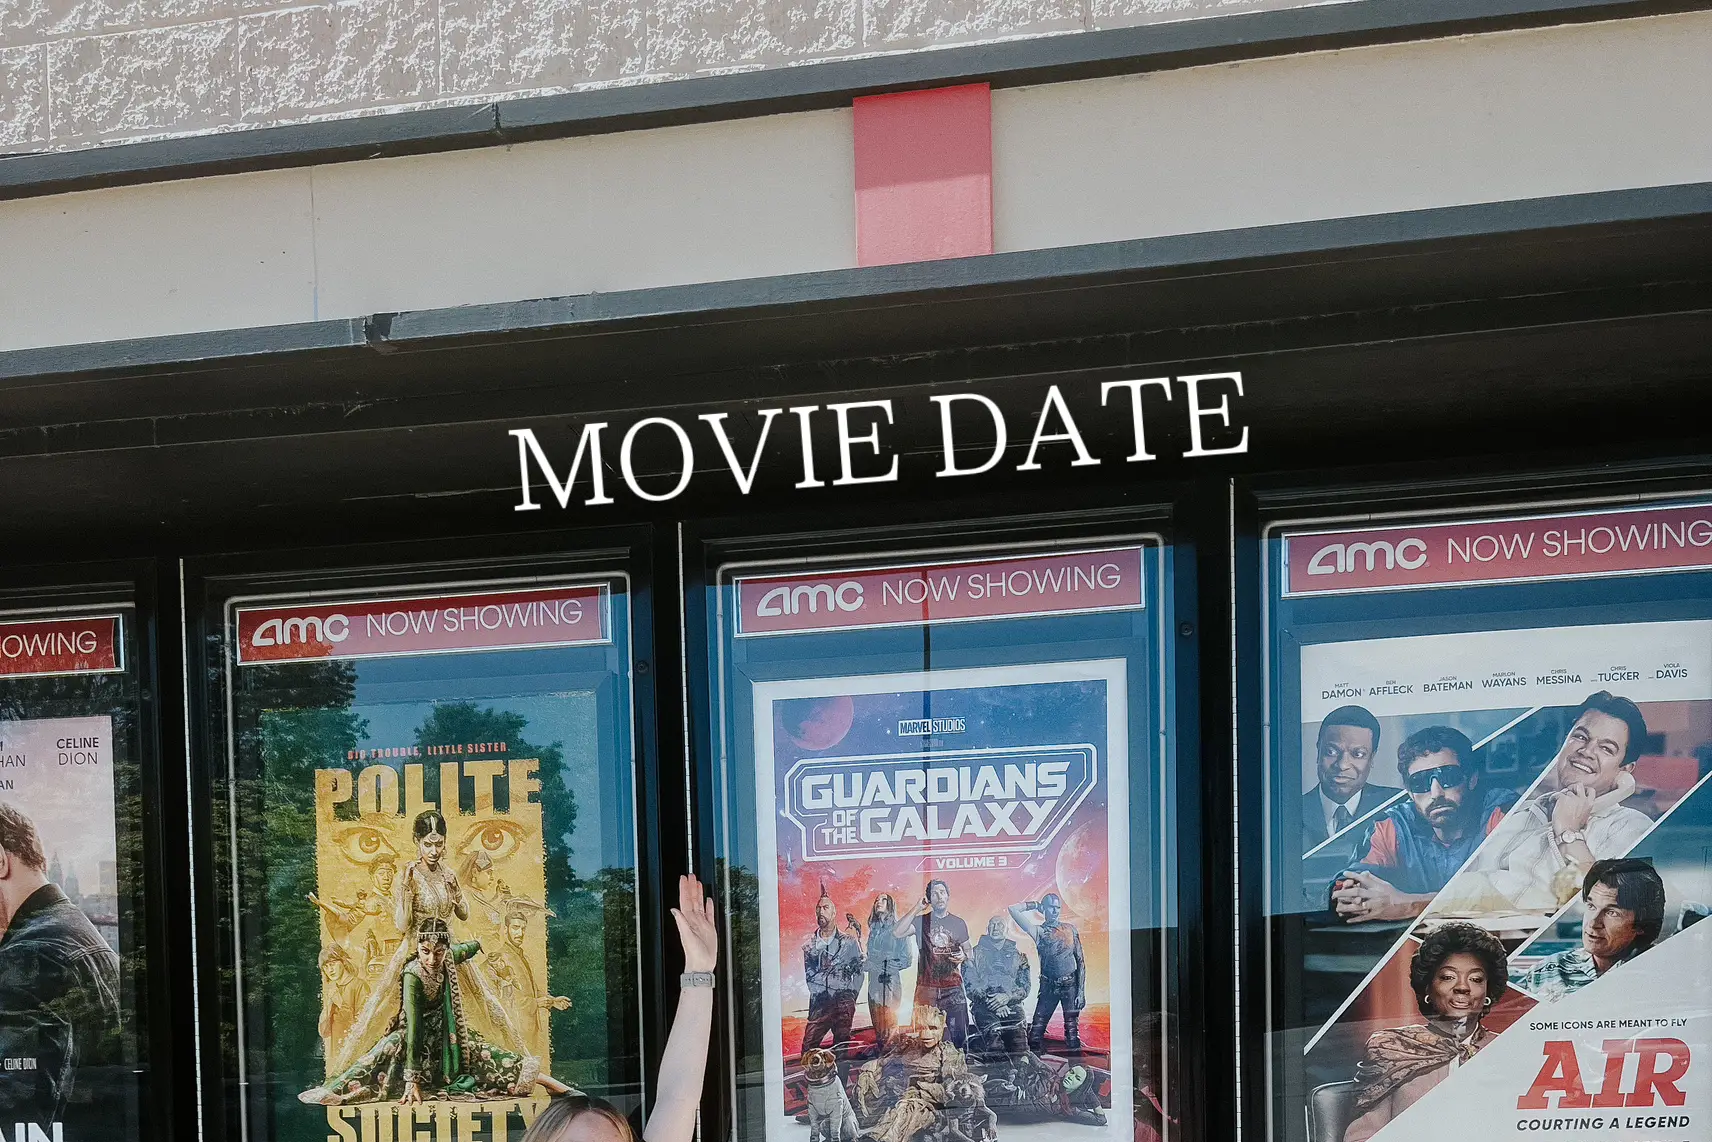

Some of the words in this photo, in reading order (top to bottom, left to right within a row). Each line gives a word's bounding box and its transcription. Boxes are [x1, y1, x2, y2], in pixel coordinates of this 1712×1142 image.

[1447, 532, 1535, 564] NOW
[1542, 519, 1712, 556] SHOWING
[882, 575, 960, 606] NOW
[967, 563, 1121, 600] SHOWING
[367, 609, 439, 637] NOW
[444, 599, 583, 632] SHOWING
[0, 631, 97, 658] OWING
[1322, 688, 1362, 700] DAMON
[1369, 684, 1414, 696] AFFLECK
[1423, 680, 1473, 693] BATEMAN
[1481, 676, 1527, 689] WAYANS
[1536, 674, 1582, 685] MESSINA
[1597, 671, 1640, 682] TUCKER
[1656, 668, 1688, 679] DAVIS
[899, 719, 932, 735] MARVEL
[932, 718, 966, 733] STUDIOS
[56, 737, 99, 749] CELINE
[427, 744, 462, 756] LITTLE
[58, 751, 98, 766] DION
[314, 758, 543, 824] POLITE
[801, 761, 1071, 810] GUARDIANS
[832, 809, 856, 828] OF
[859, 799, 1059, 843] GALAXY
[821, 826, 860, 845] THE
[935, 856, 996, 870] VOLUME
[998, 856, 1008, 867] 3
[1530, 1022, 1559, 1031] SOME
[1561, 1020, 1594, 1030] ICONS
[1596, 1020, 1616, 1029] ARE
[1619, 1019, 1653, 1028] MEANT
[1655, 1018, 1668, 1027] TO
[1671, 1018, 1688, 1027] FLY
[1517, 1037, 1691, 1110] AIR
[1516, 1117, 1604, 1131] COURTING
[1609, 1118, 1620, 1129] A
[1626, 1115, 1690, 1129] LEGEND
